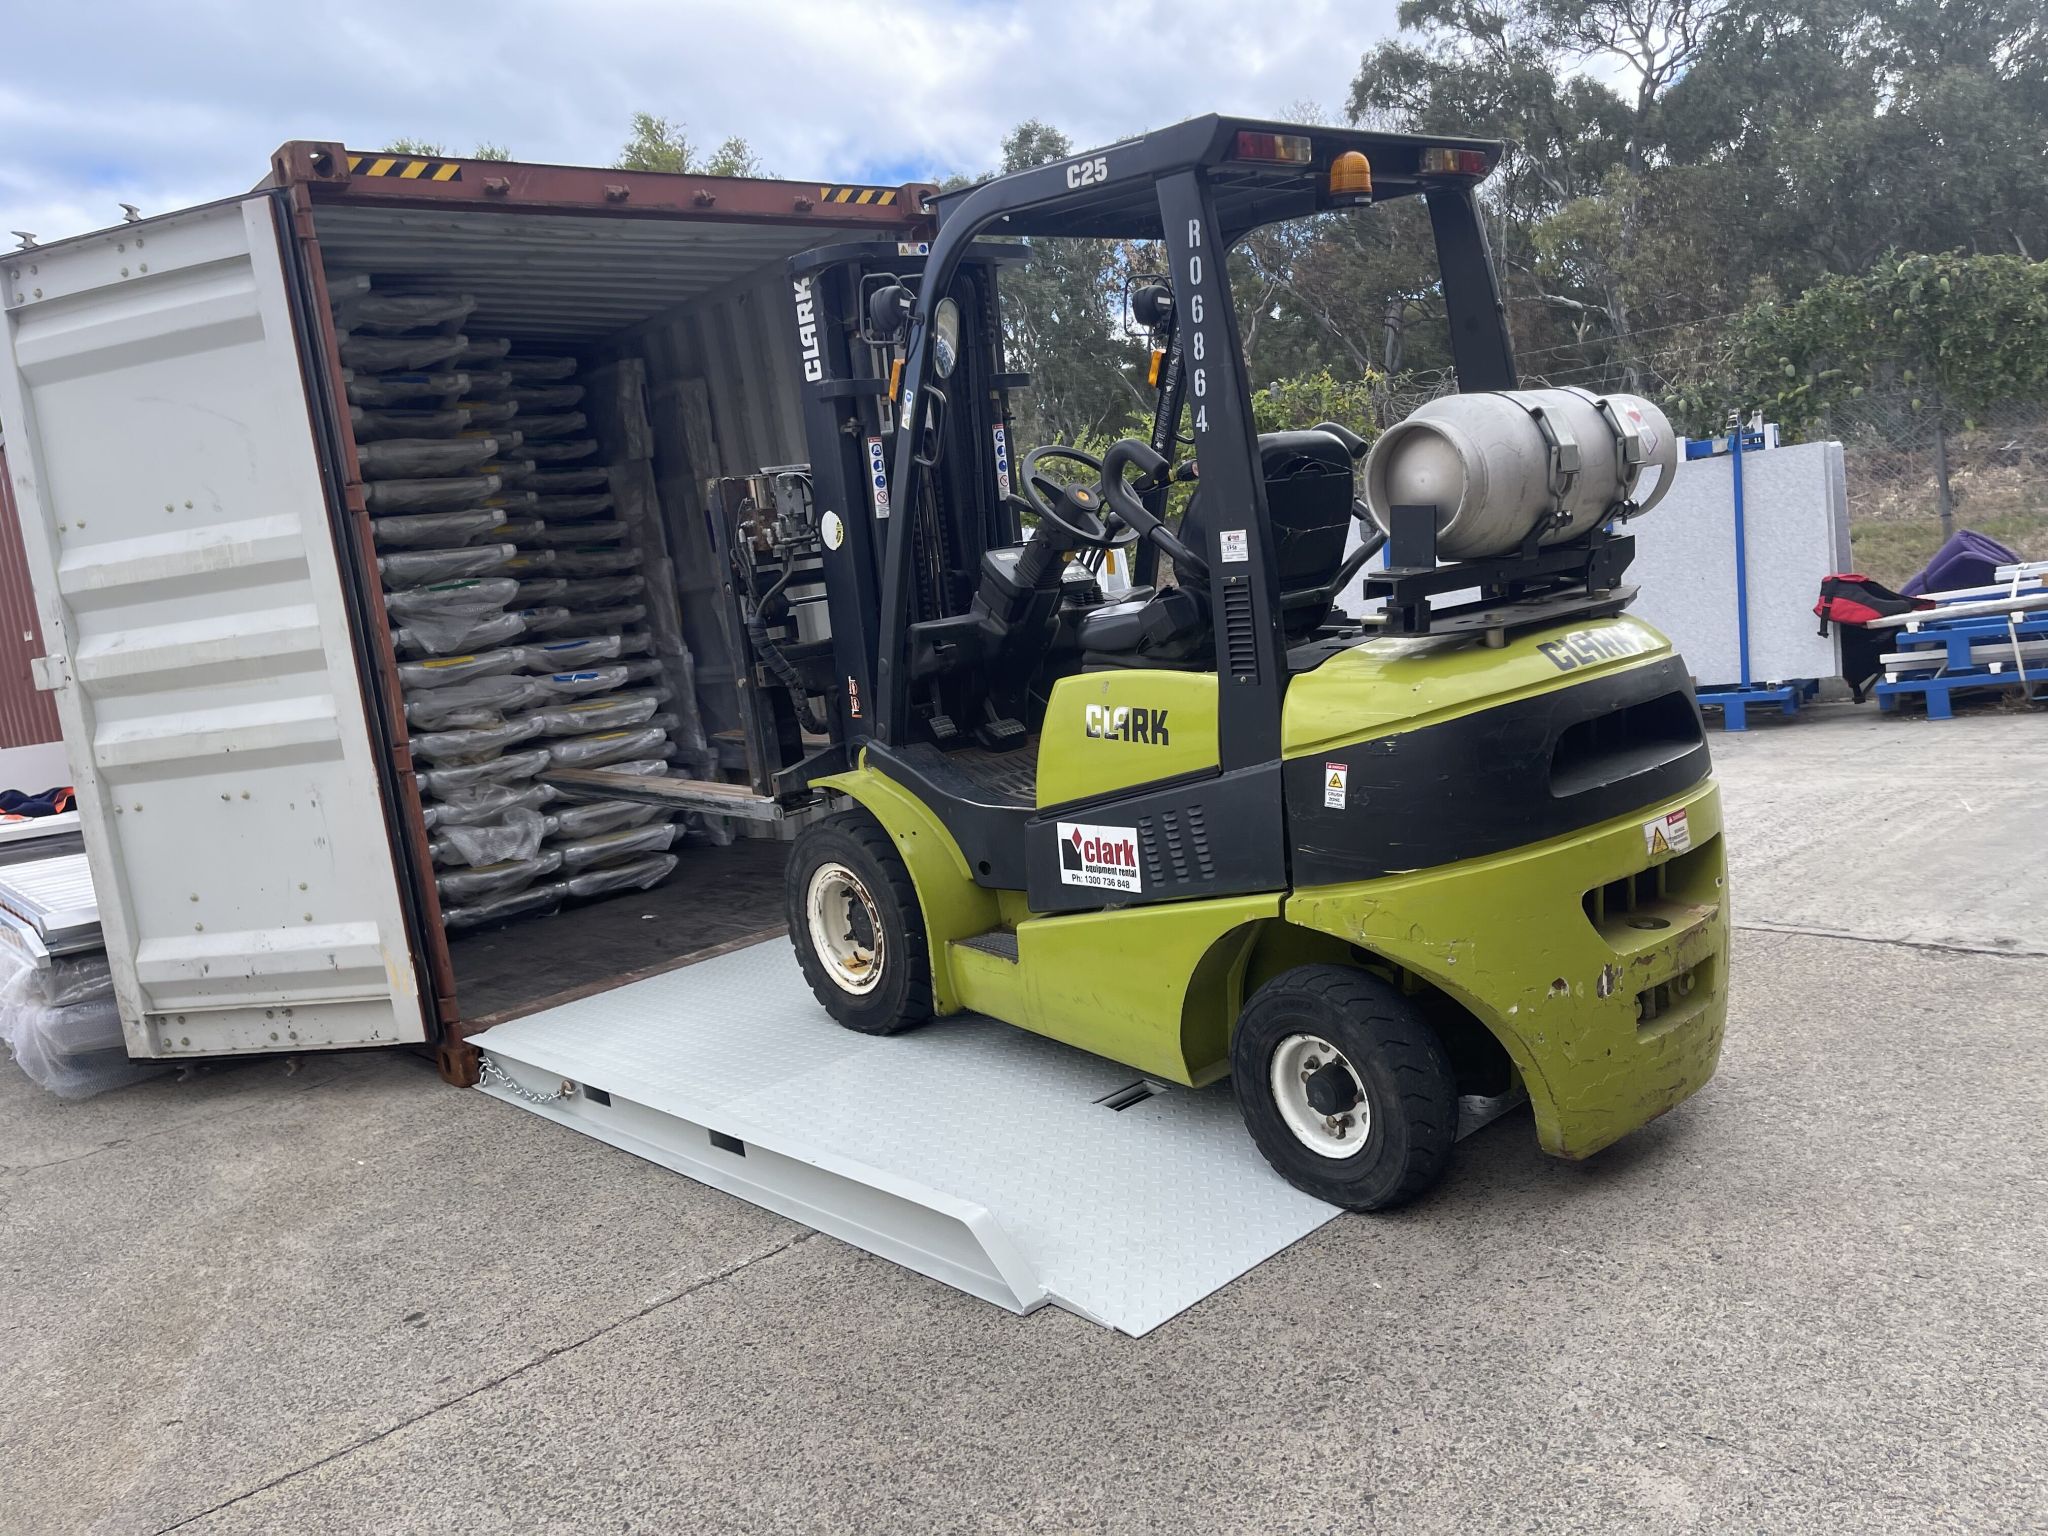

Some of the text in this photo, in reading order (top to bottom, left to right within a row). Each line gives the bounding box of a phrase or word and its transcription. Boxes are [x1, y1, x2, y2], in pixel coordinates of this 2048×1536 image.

[1066, 157, 1108, 189] C25
[793, 277, 822, 382] CLARK
[1188, 219, 1208, 432] R06864
[1085, 704, 1170, 746] CLARK
[1084, 837, 1136, 867] clark
[1071, 873, 1130, 889] Ph: 1300 736 848
[1085, 864, 1137, 879] equipment rental
